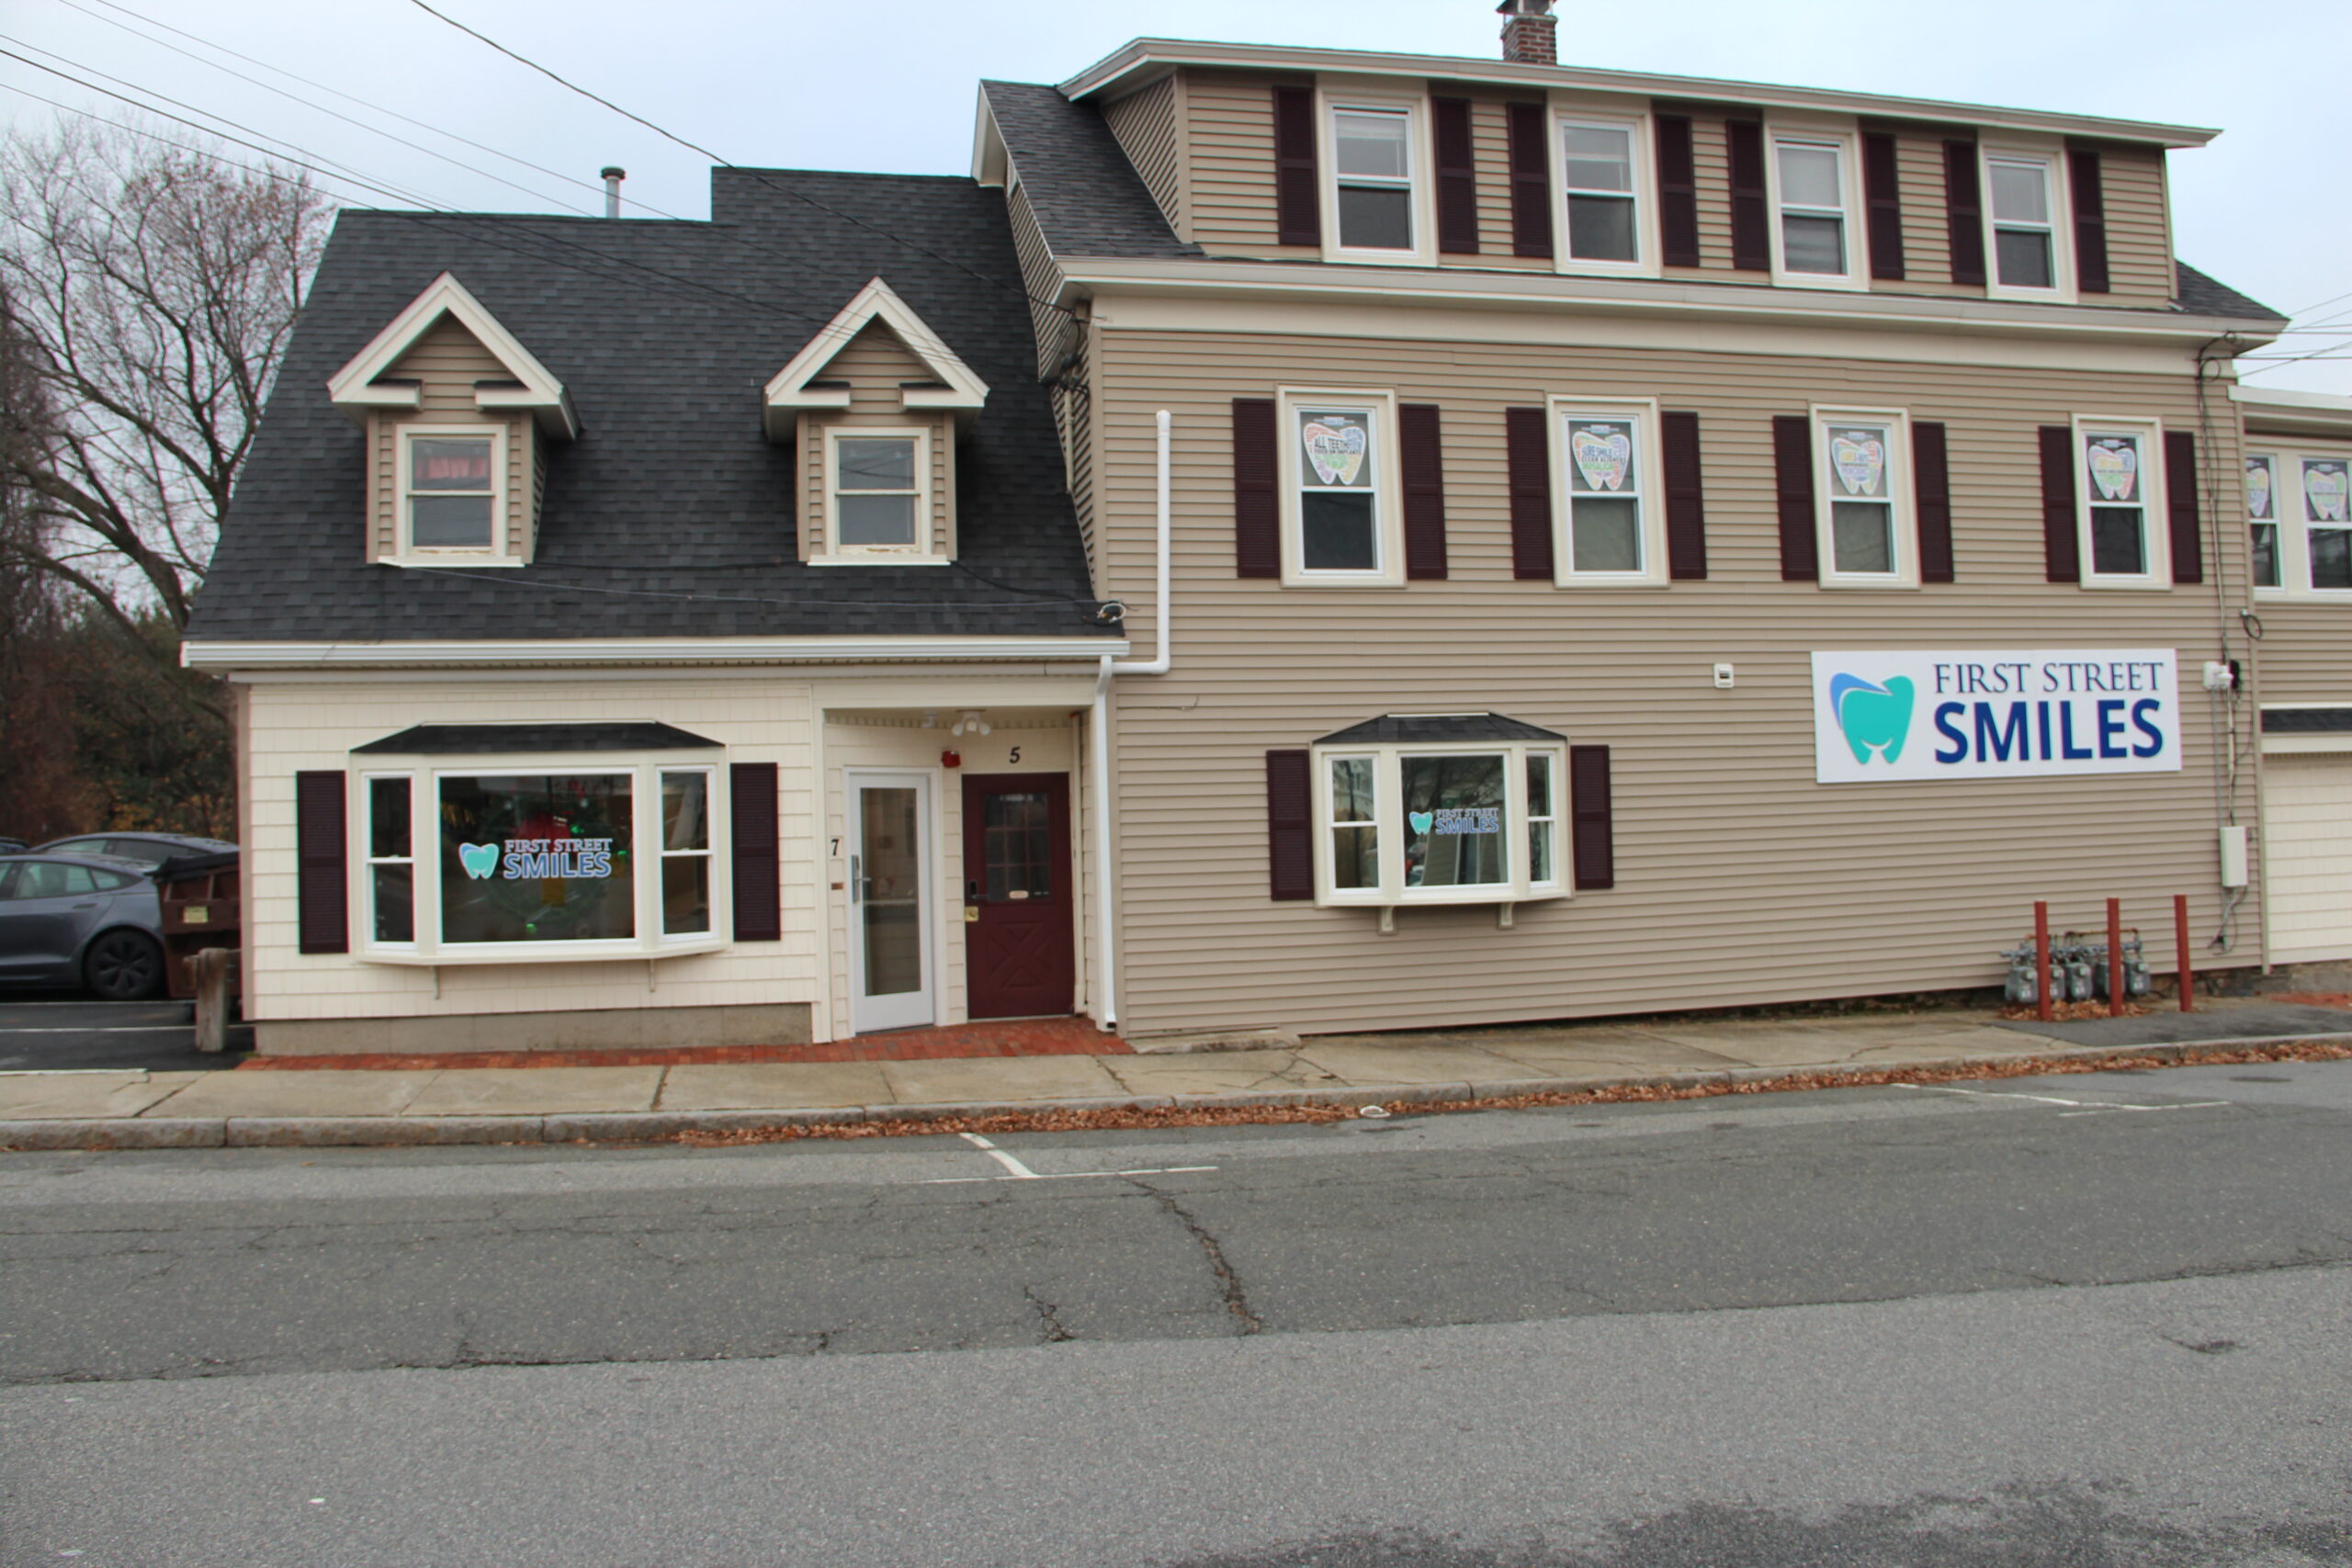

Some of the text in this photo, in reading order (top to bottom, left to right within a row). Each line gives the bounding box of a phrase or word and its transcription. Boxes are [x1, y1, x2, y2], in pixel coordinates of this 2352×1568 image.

[1933, 662, 2164, 694] FIRST STREET
[1934, 698, 2164, 764] SMILES
[1009, 746, 1021, 764] 5
[1435, 817, 1499, 835] SMILES
[504, 838, 613, 853] FIRST STREET
[831, 838, 840, 856] 7
[503, 852, 612, 879] SMILES
